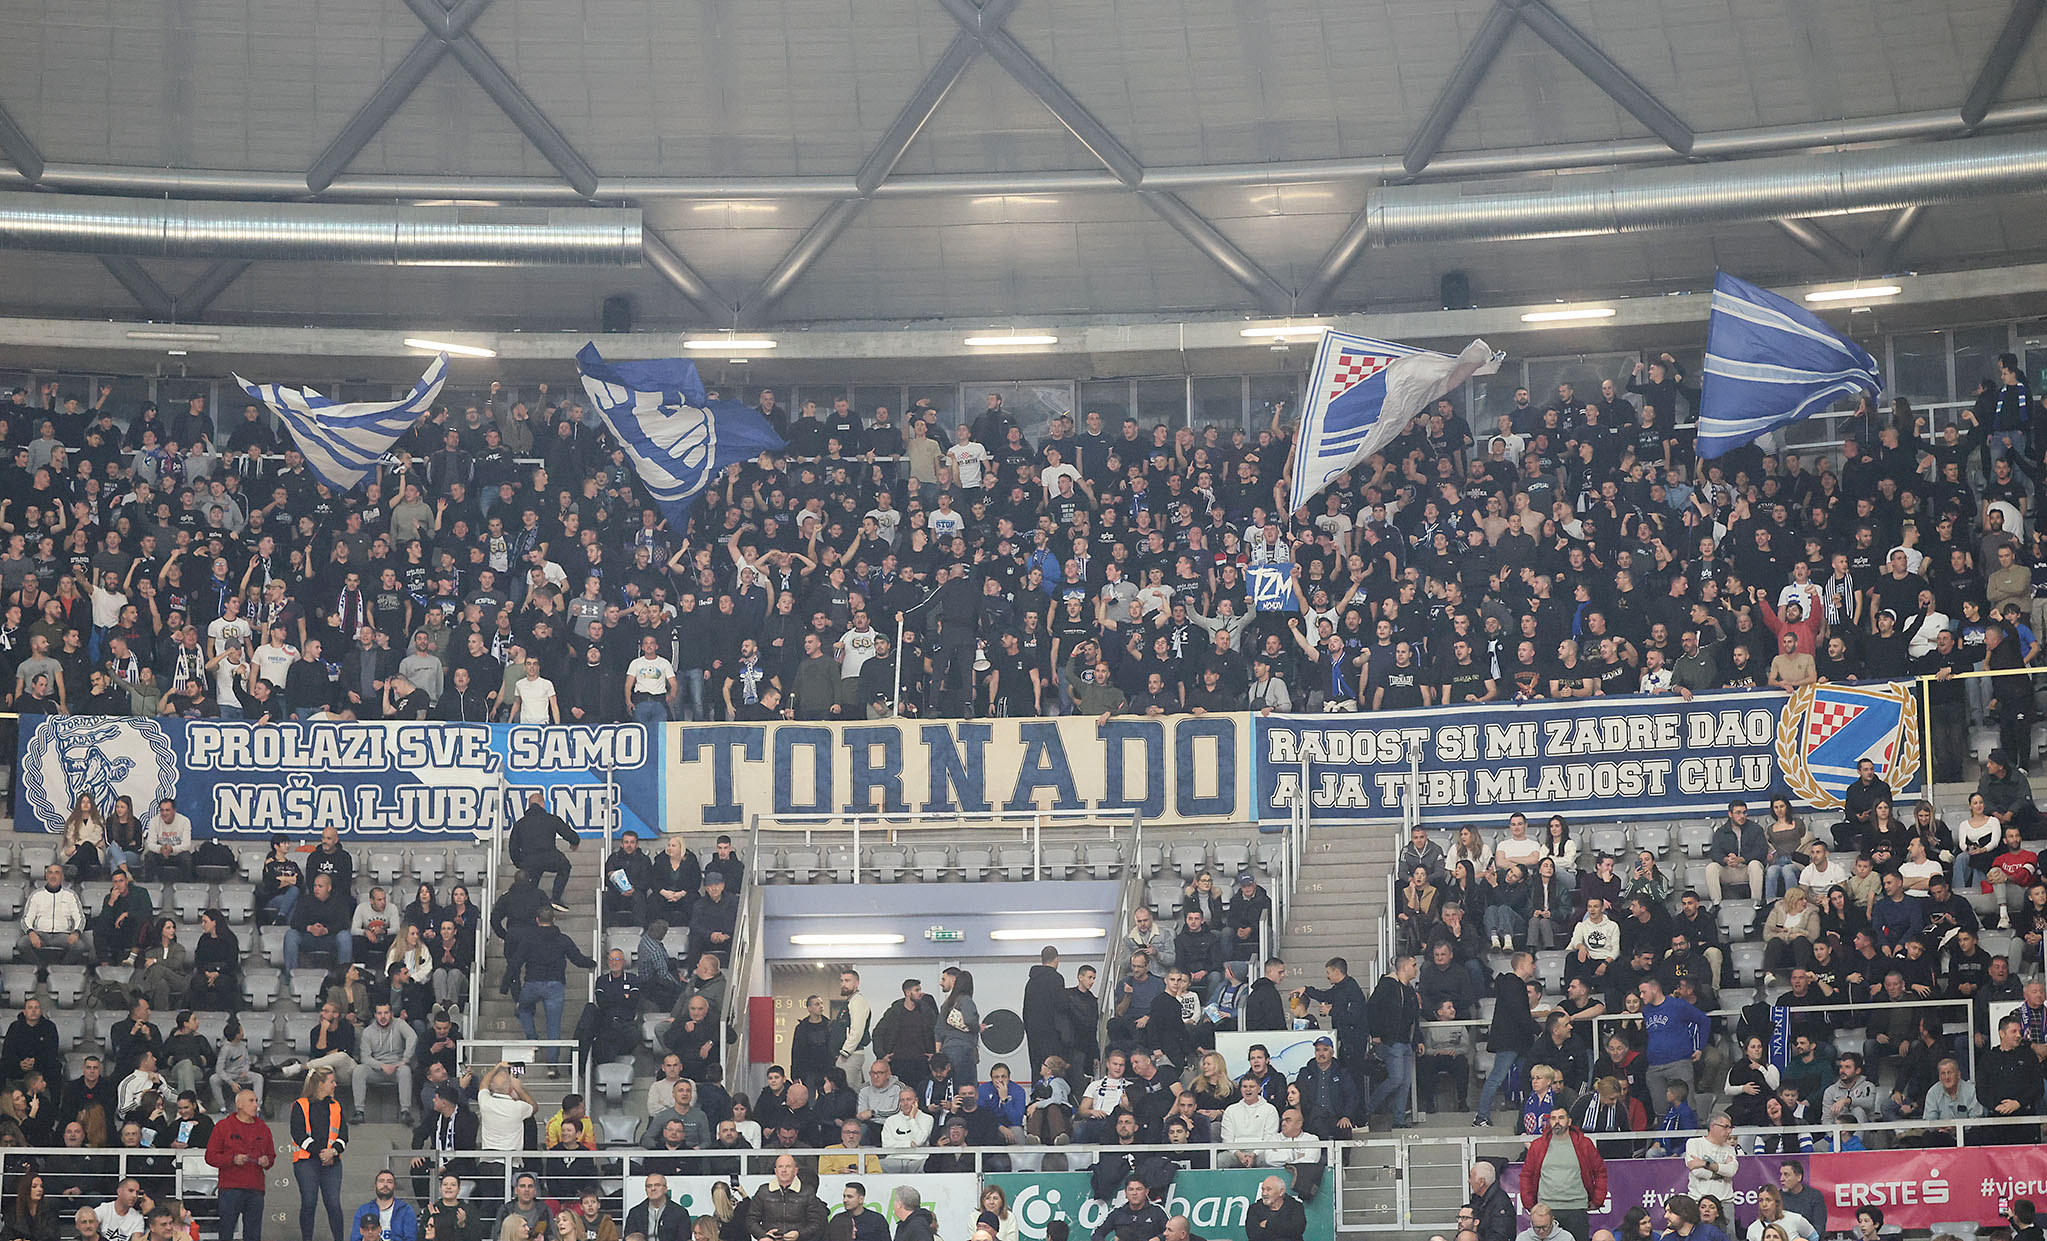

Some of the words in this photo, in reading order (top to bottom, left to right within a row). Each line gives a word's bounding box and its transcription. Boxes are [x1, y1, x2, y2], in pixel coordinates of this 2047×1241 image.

[936, 520, 956, 529] STOP
[1247, 565, 1293, 606] TZM
[852, 637, 872, 649] 60
[63, 715, 108, 732] TORNADO
[1269, 728, 1430, 764] RADOST
[1436, 725, 1478, 761] SI
[1485, 722, 1538, 759] MI
[1544, 713, 1682, 756] ZADRE
[1687, 709, 1773, 749] DAO
[64, 735, 97, 751] ZADAR
[189, 725, 388, 769] PROLAZI
[399, 727, 501, 772] SVE,
[509, 725, 643, 769] SAMO
[681, 718, 1233, 826] TORNADO
[1271, 772, 1302, 808] A
[1312, 772, 1370, 808] JA
[1474, 758, 1672, 805] MLADOST
[1677, 755, 1773, 795] CILU
[217, 777, 348, 830] NAŠA
[552, 787, 617, 830] NE
[1321, 843, 1332, 852] 17
[1312, 884, 1323, 892] 16
[1301, 925, 1312, 934] 15
[1292, 967, 1303, 976] 14
[775, 999, 782, 1009] 8
[786, 999, 793, 1009] 9
[775, 1033, 784, 1044] D
[282, 1177, 290, 1187] 9
[1834, 1181, 1919, 1207] ERSTE
[279, 1211, 287, 1222] 8
